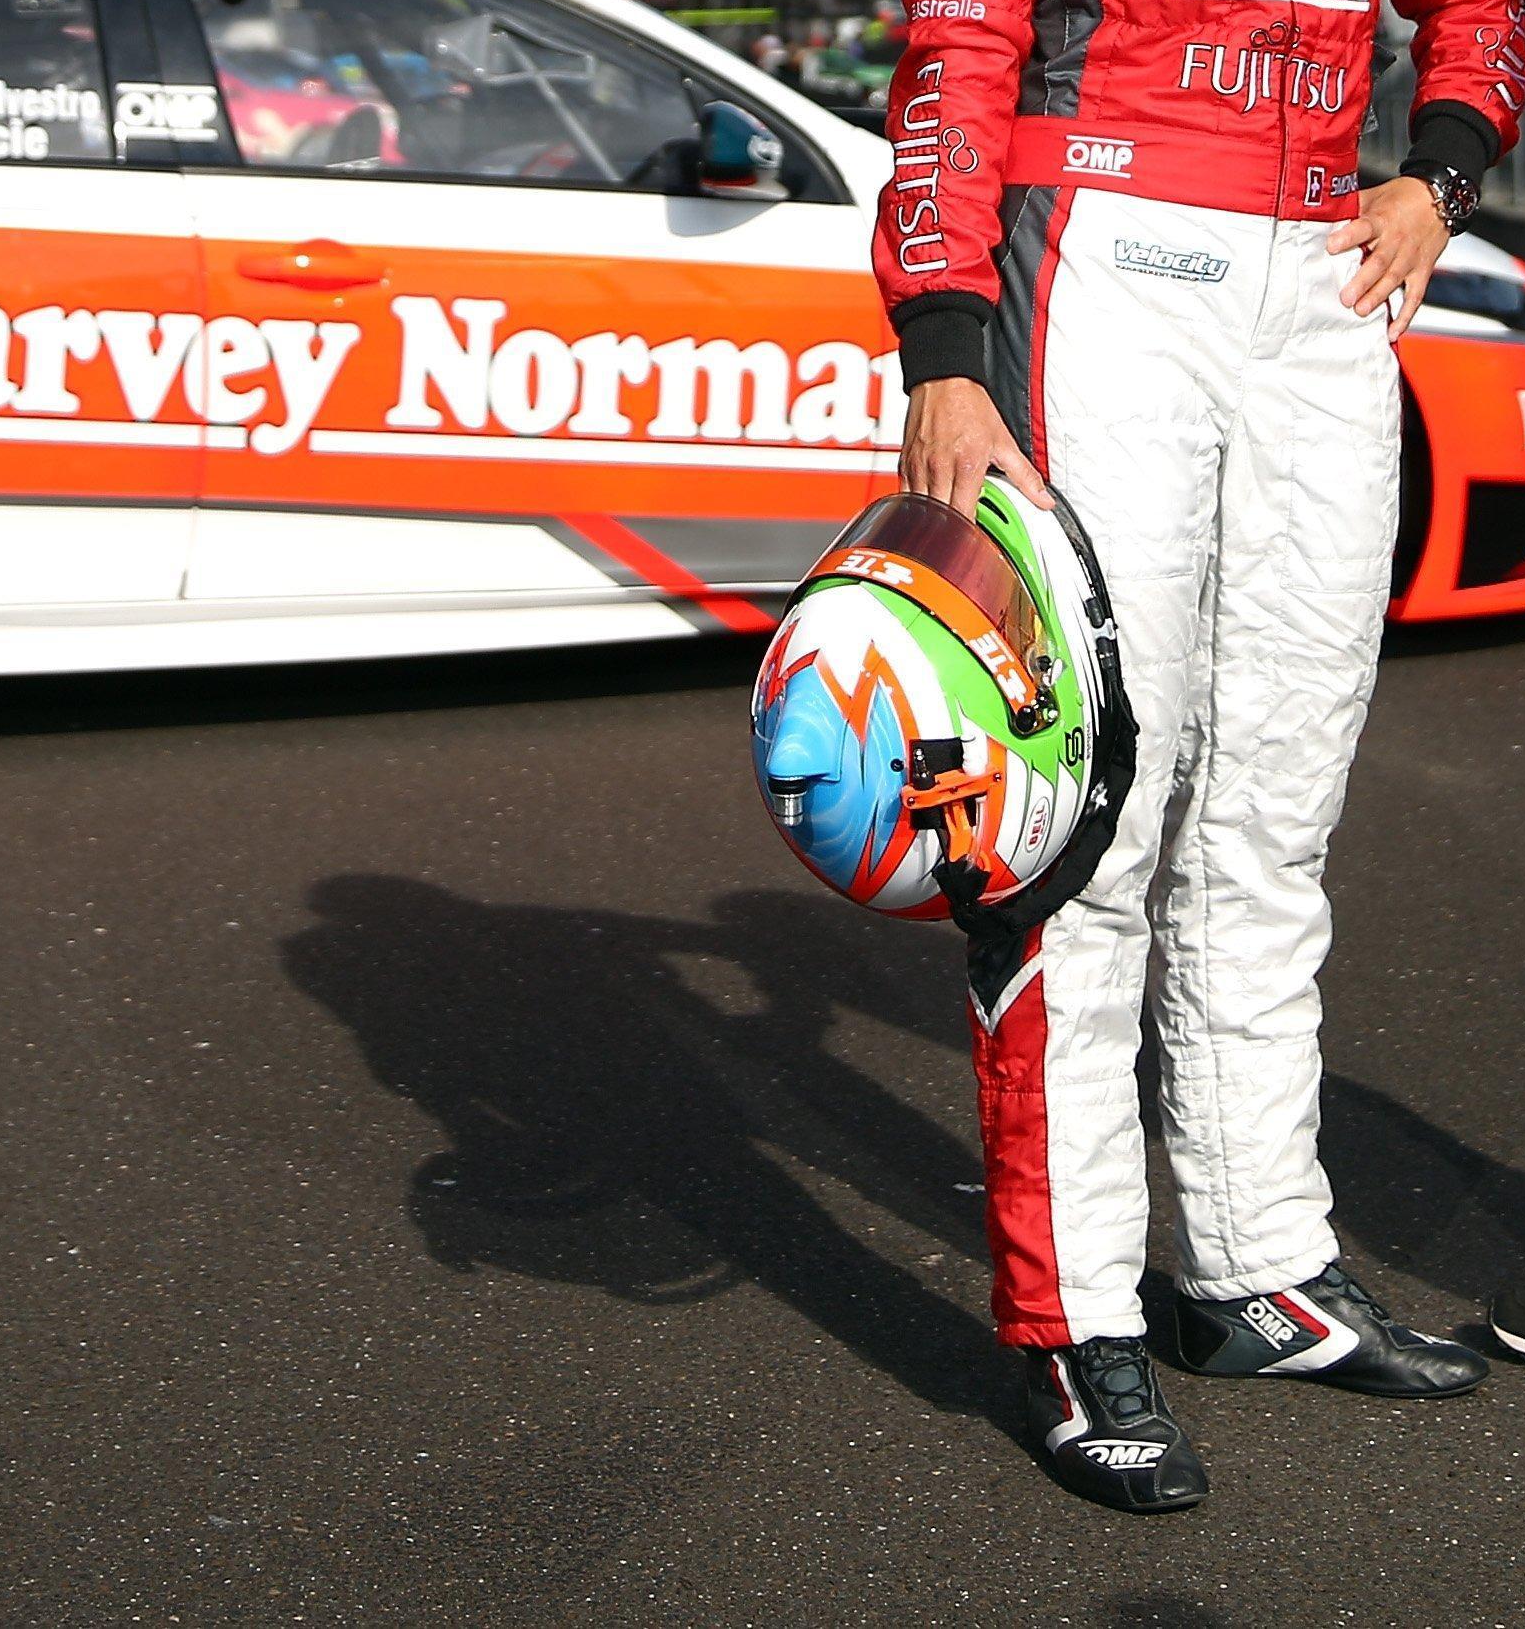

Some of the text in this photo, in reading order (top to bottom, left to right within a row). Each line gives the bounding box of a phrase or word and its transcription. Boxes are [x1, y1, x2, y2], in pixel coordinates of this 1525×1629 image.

[1177, 43, 1345, 114] FUJITSU
[893, 61, 949, 275] FUJITSU
[1065, 140, 1134, 172] OMP
[1115, 238, 1231, 283] Velocity
[1027, 803, 1047, 847] BELL
[1245, 1299, 1298, 1345] OMP
[1085, 1445, 1167, 1466] OMP
